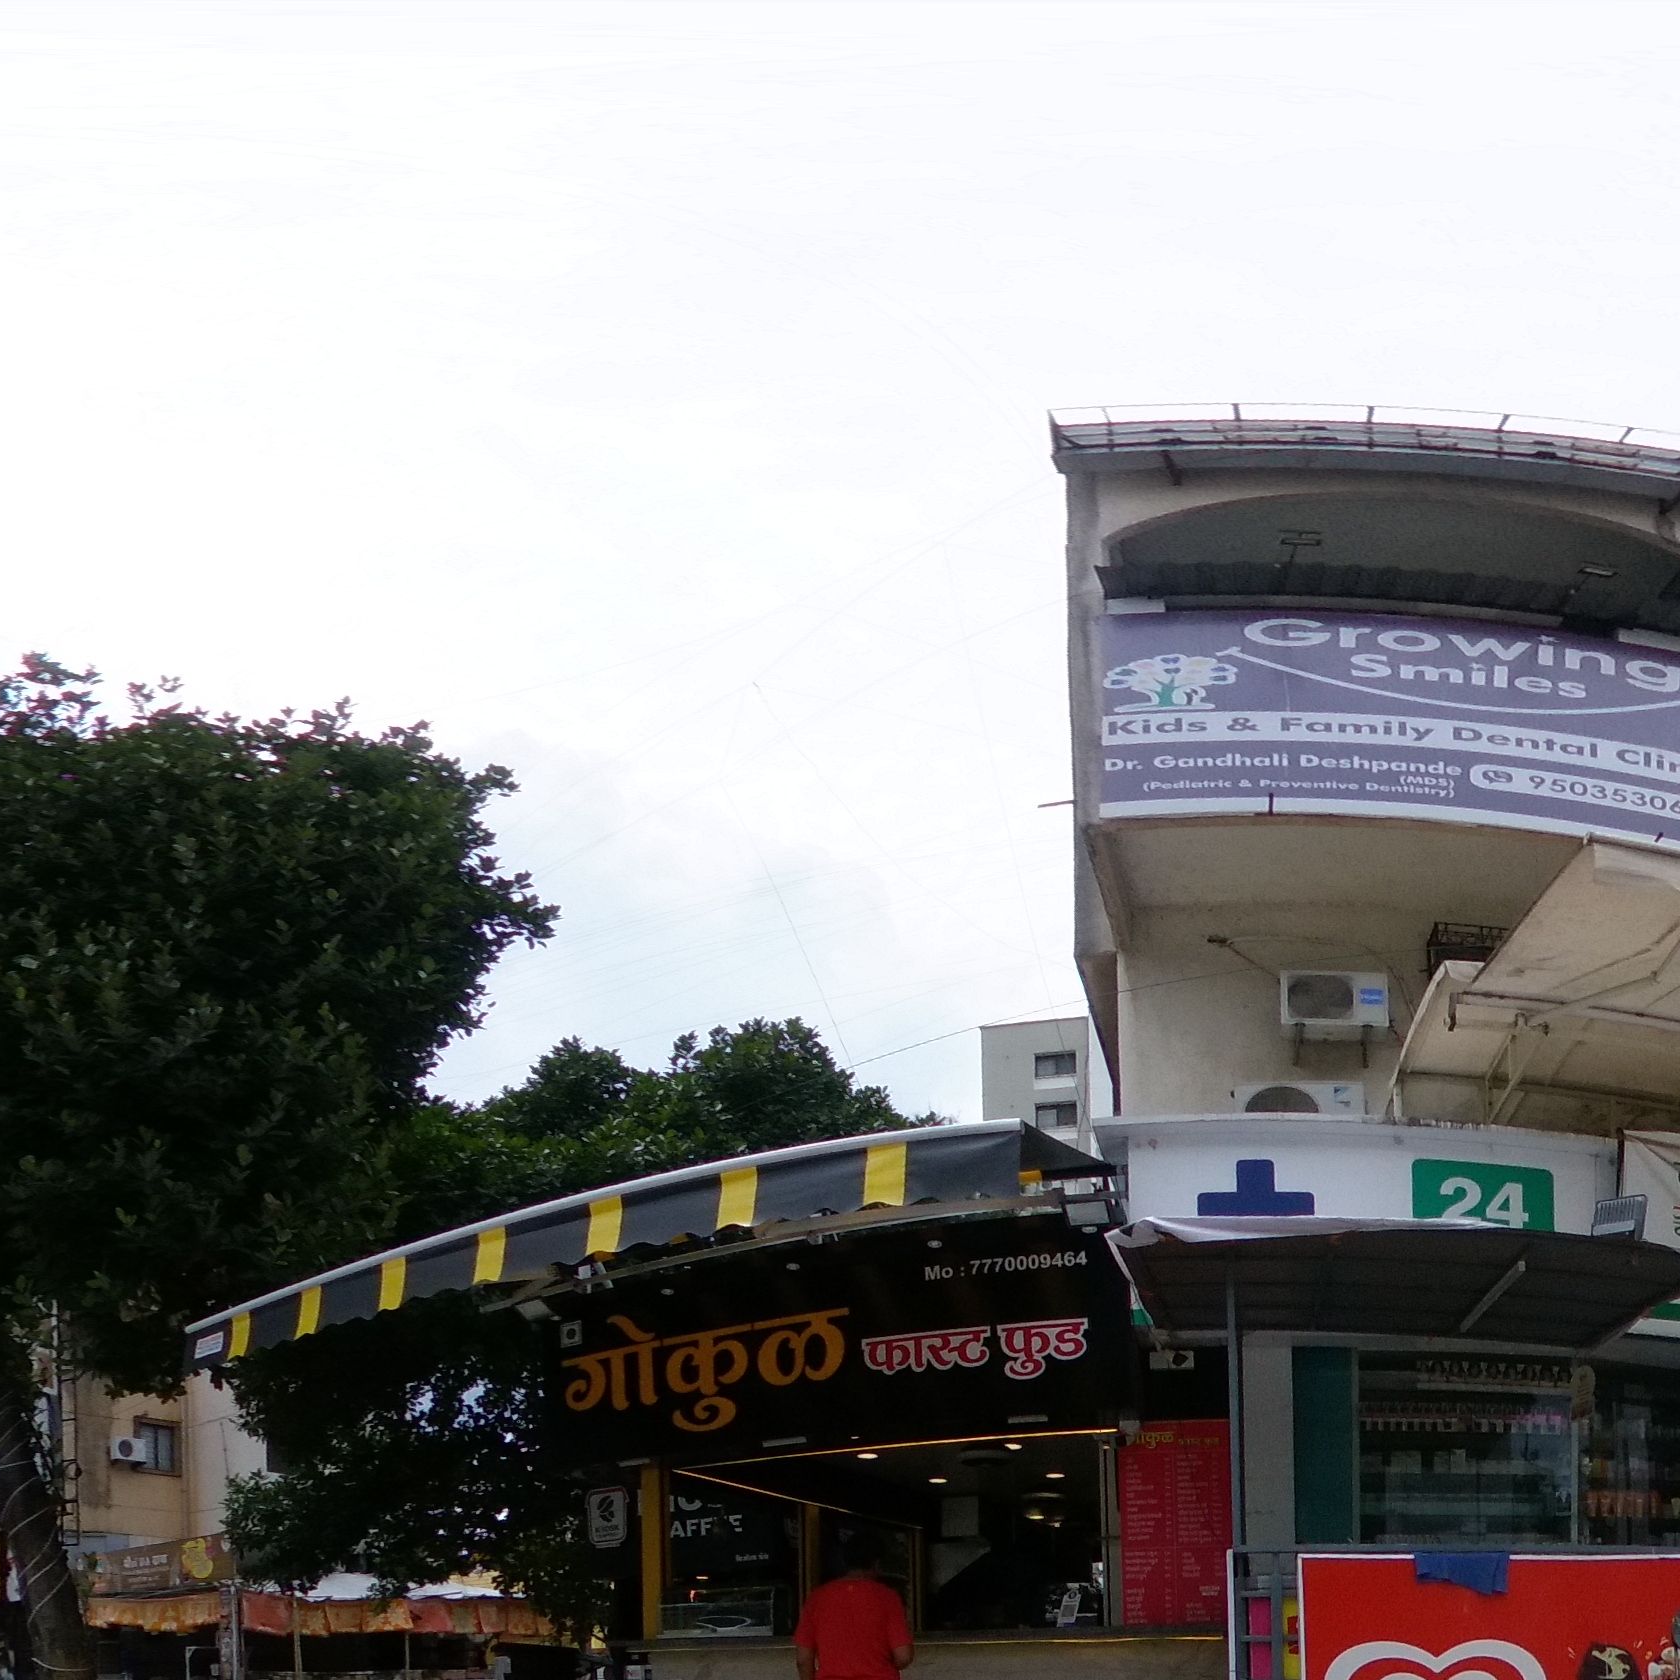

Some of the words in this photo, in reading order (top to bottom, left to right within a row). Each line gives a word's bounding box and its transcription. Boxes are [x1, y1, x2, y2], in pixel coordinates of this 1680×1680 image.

[1244, 618, 1680, 693] Growing
[1350, 654, 1586, 698] Smiles
[1108, 718, 1207, 736] Kids
[1226, 717, 1261, 732] &
[1280, 717, 1434, 742] Family
[1453, 727, 1599, 758] Dental
[1105, 757, 1143, 771] Dr.
[1154, 753, 1289, 769] Gandhali
[1300, 753, 1463, 776] Deshpande
[1400, 775, 1455, 788] (MDS)
[1143, 779, 1233, 792] (Pediatric
[1239, 779, 1253, 788] &
[1260, 779, 1360, 791] Preventive
[1366, 780, 1455, 799] Dentistry)
[1439, 1176, 1529, 1229] 24
[924, 1265, 954, 1281] Mo
[970, 1251, 1088, 1276] 7770009464
[562, 1307, 850, 1432] गोकुळ
[862, 1325, 991, 1377] फास्ट
[997, 1317, 1088, 1380] फुड
